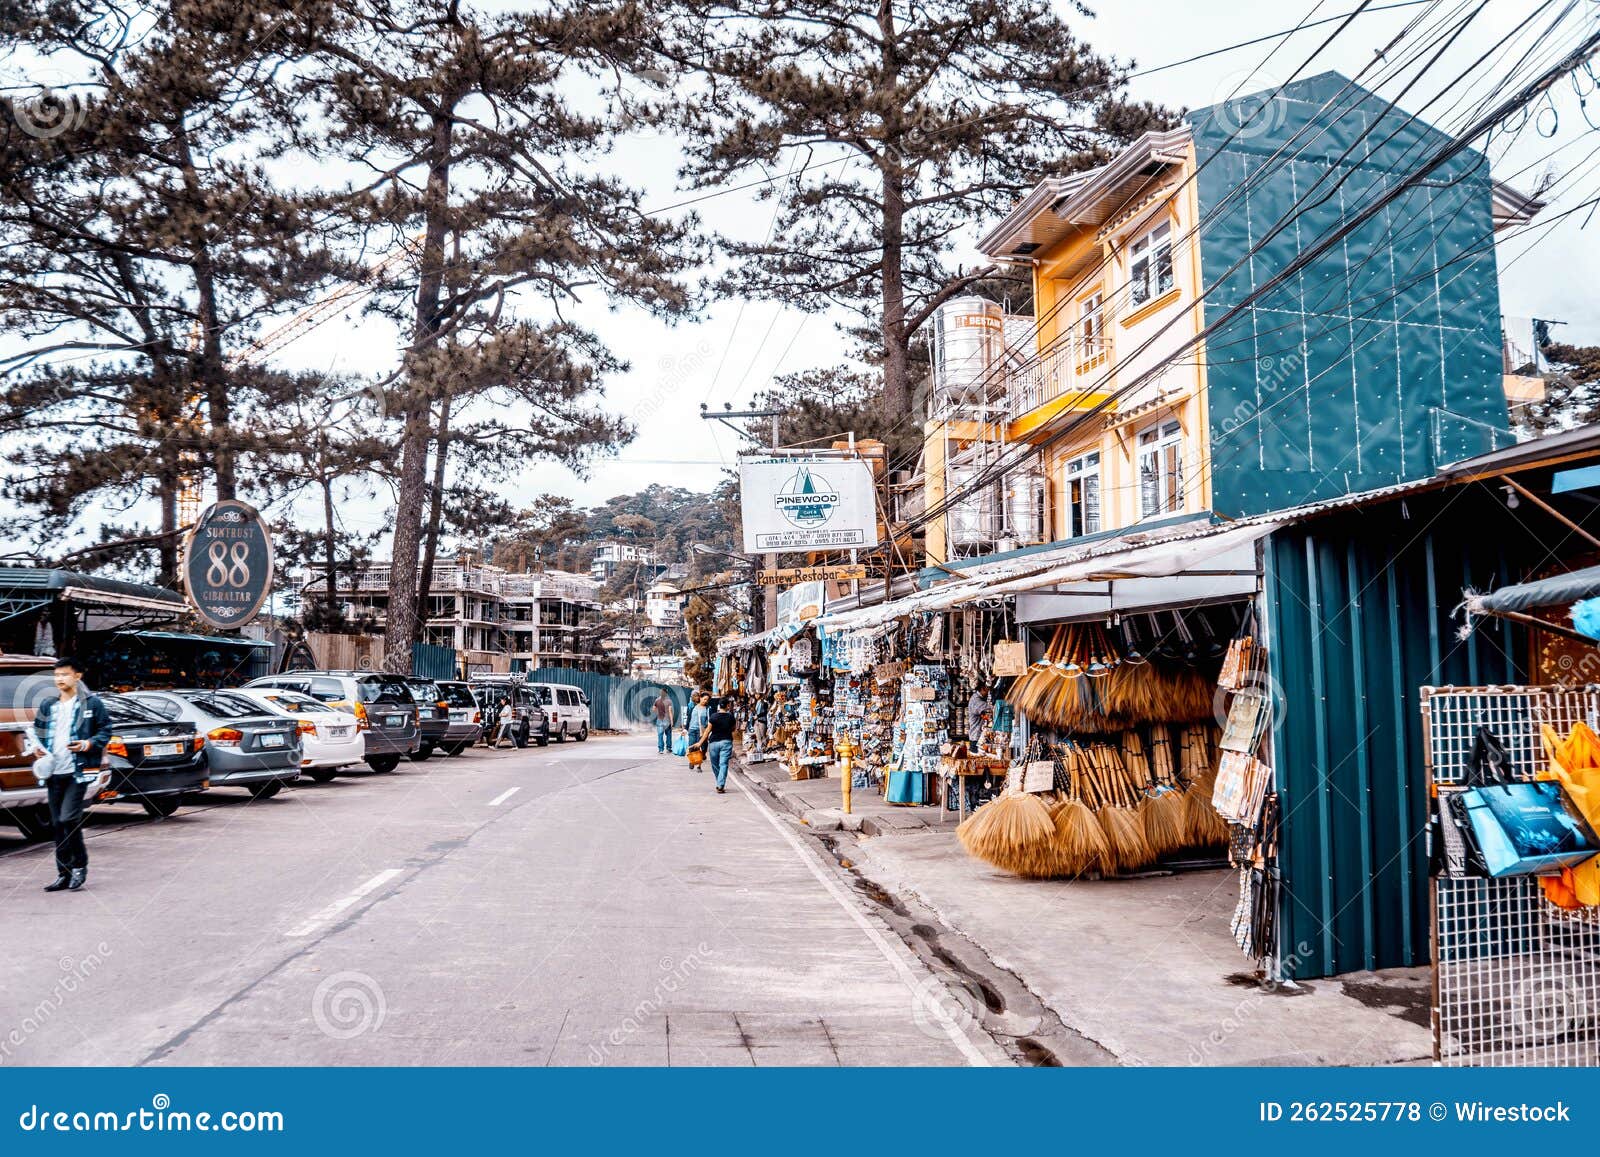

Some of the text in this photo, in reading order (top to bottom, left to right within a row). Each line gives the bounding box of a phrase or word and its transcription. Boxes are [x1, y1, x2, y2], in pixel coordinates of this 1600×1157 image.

[776, 494, 838, 505] PINEWOOD
[206, 527, 255, 539] SUNTRUST
[206, 540, 250, 588] 88
[794, 568, 840, 582] Restobar
[202, 591, 252, 602] GIBRALTAR
